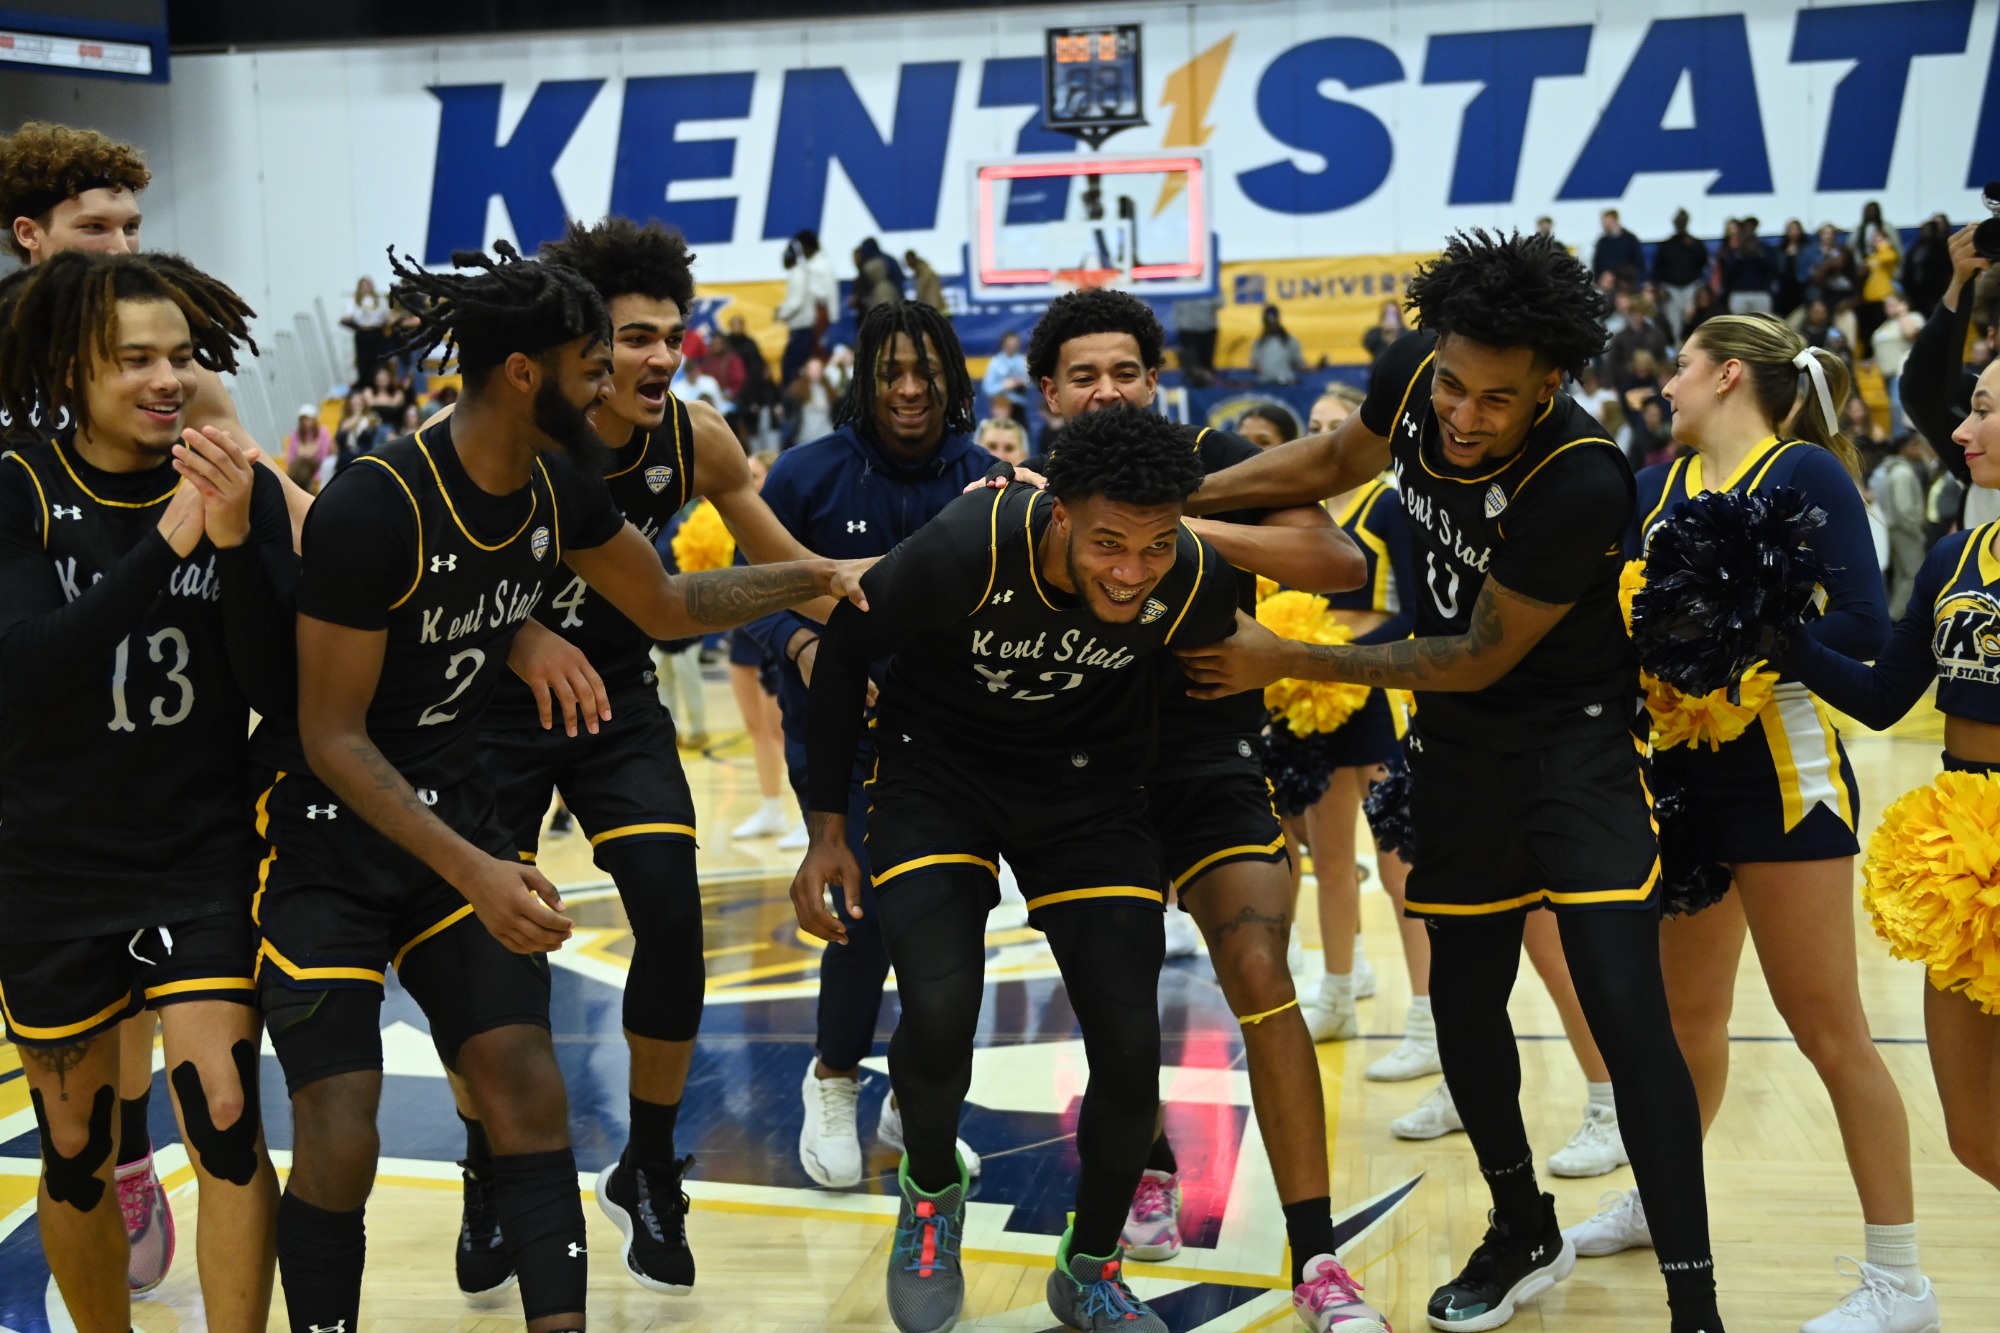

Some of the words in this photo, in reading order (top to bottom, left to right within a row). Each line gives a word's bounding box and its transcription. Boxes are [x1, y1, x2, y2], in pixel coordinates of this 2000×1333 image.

[424, 56, 1134, 265] KENT
[1236, 0, 2000, 215] STAT
[1439, 508, 1492, 574] Stat
[419, 593, 485, 644] Kent
[551, 575, 588, 629] 4
[107, 626, 195, 732] 13
[971, 630, 1047, 659] Kent
[1053, 628, 1135, 669] State
[416, 647, 486, 727] 2
